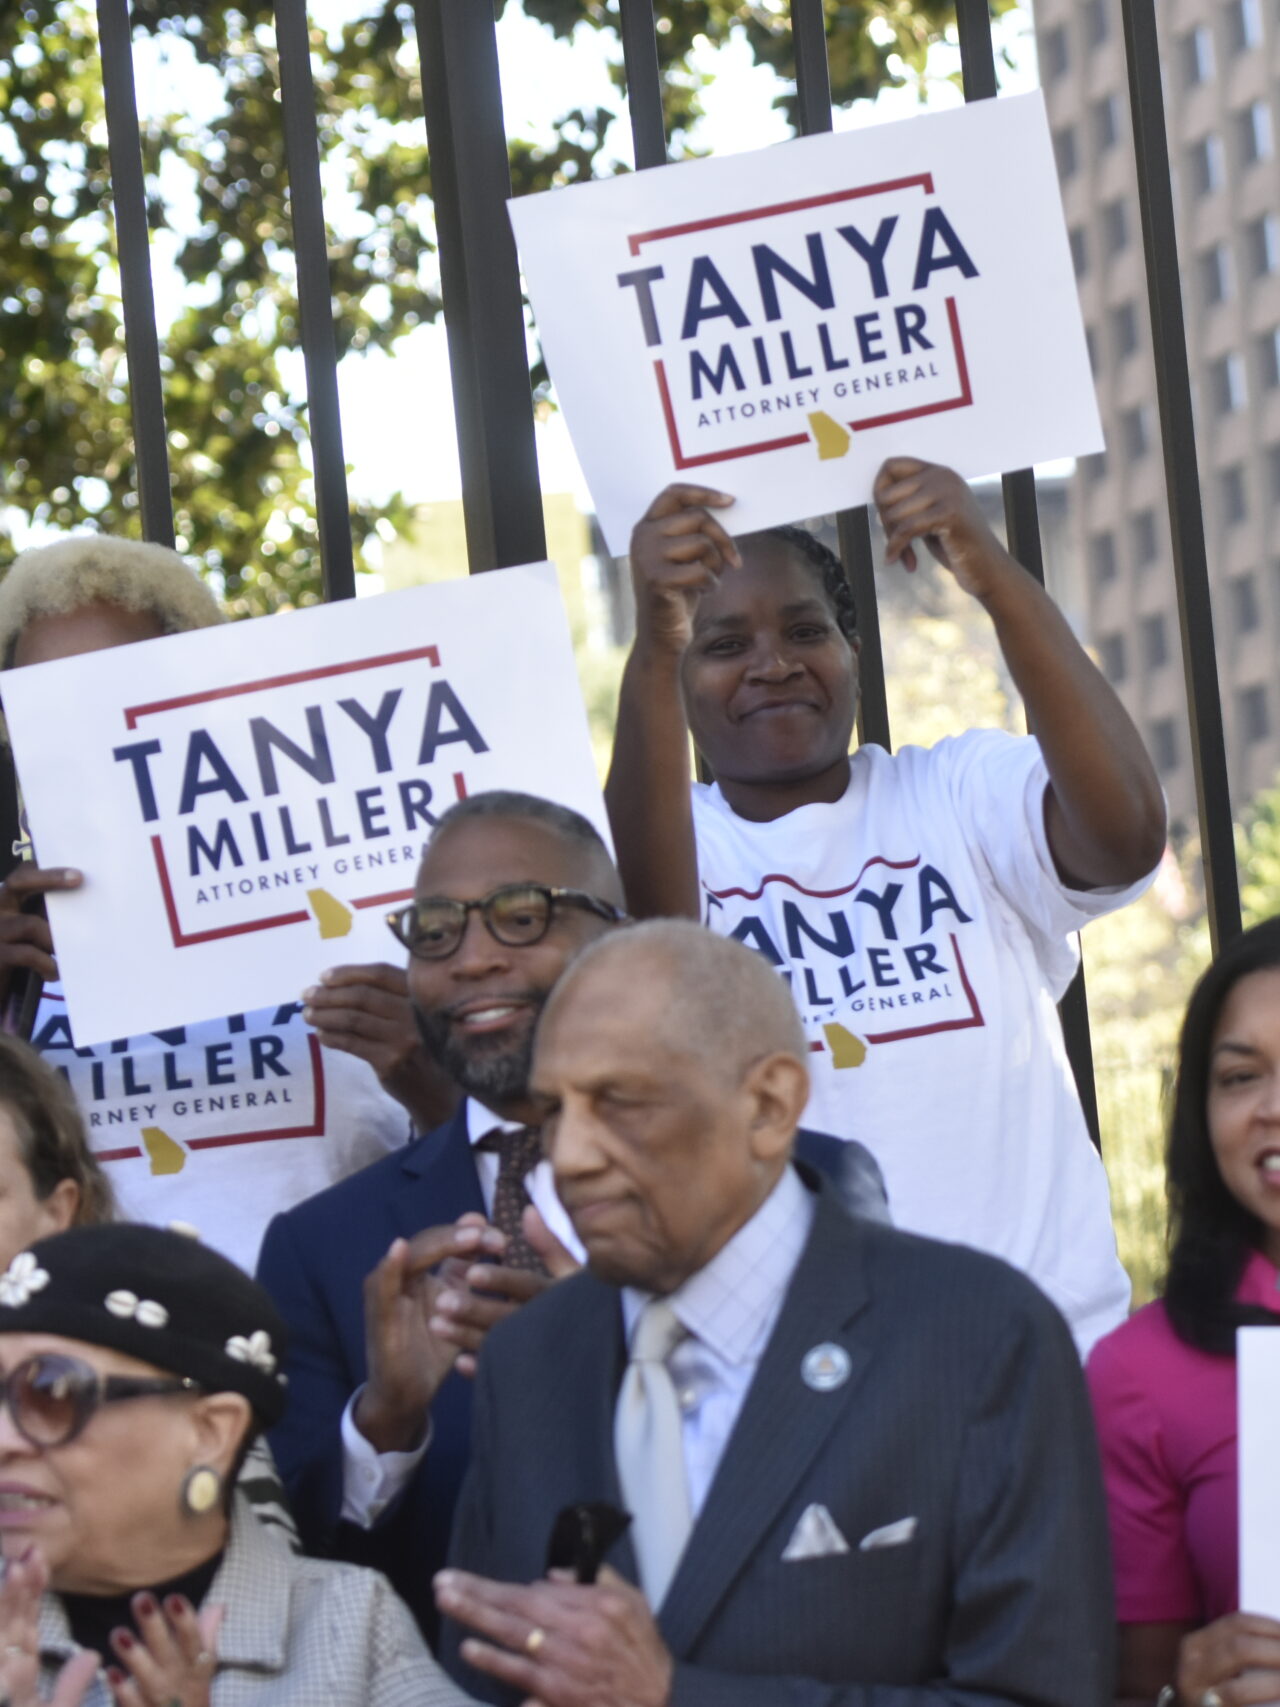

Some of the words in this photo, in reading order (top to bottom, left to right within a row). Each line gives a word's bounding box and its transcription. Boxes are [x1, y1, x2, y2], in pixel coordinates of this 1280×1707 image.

[616, 206, 980, 347] TANYA
[689, 303, 935, 401] MILLER
[697, 387, 822, 428] ATTORNEY
[833, 363, 940, 398] GENERAL
[112, 679, 490, 823] TANYA
[186, 778, 438, 877] MILLER
[195, 864, 320, 904] ATTORNEY
[851, 983, 953, 1012] GENERAL
[172, 1088, 293, 1117] GENERAL
